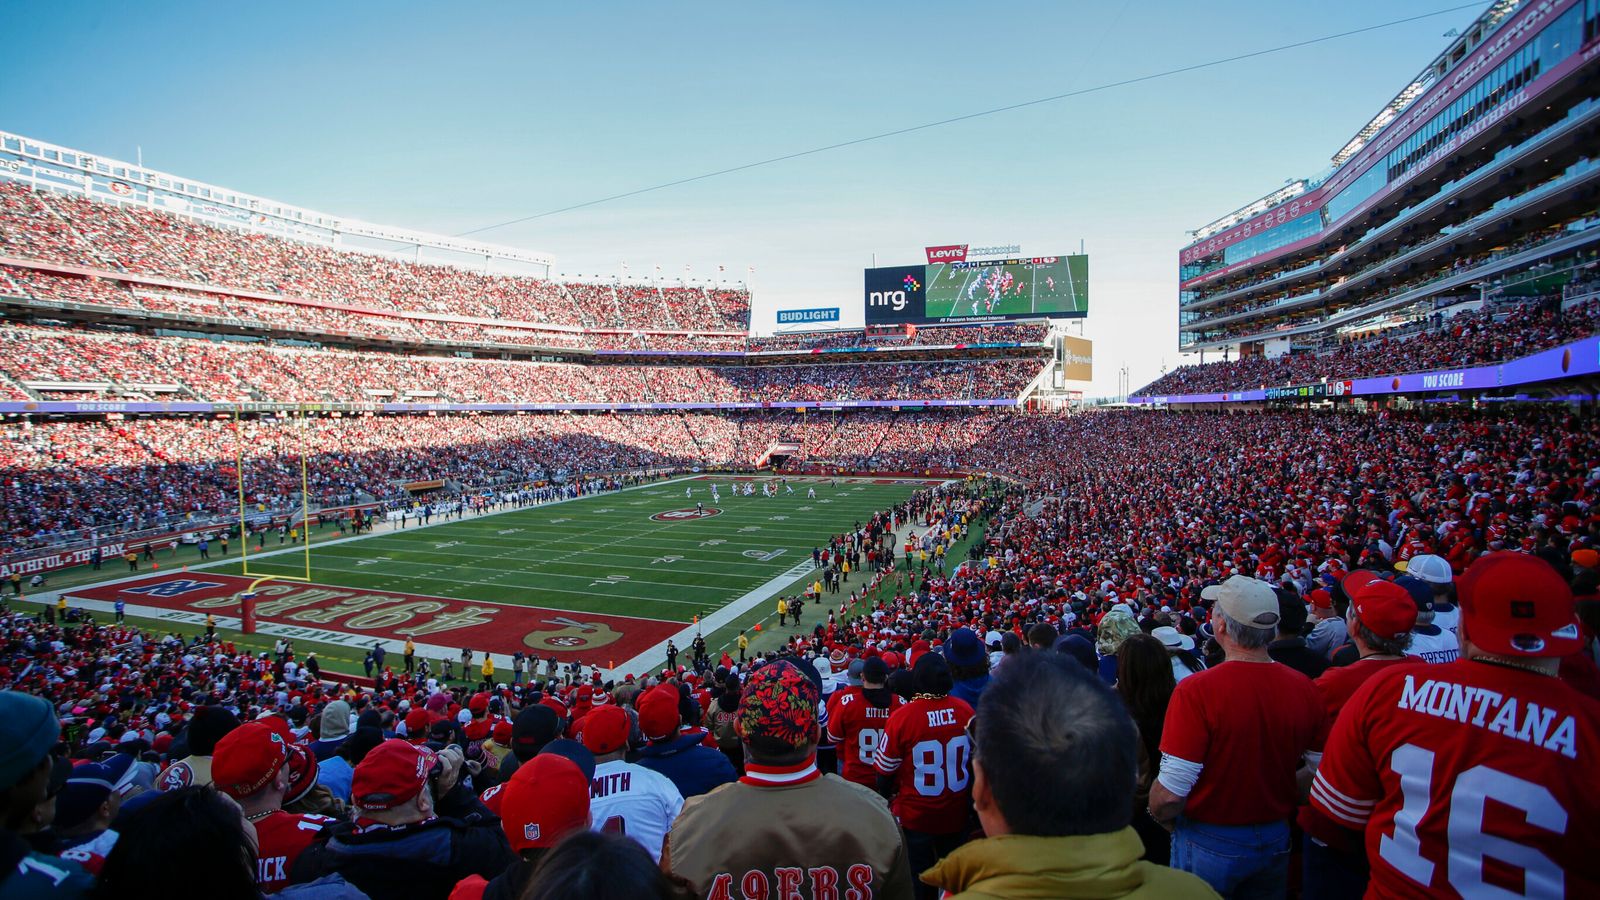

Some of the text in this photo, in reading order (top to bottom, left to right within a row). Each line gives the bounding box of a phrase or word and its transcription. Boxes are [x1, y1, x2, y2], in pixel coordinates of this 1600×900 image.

[1375, 117, 1411, 154] SUPER
[1413, 86, 1450, 123] BOWL
[1390, 164, 1417, 193] HOME
[1418, 157, 1431, 172] OF
[1433, 140, 1457, 162] THE
[1460, 90, 1530, 146] FAITHFUL
[1423, 373, 1465, 388] YOU SCORE
[76, 403, 127, 411] YOU SCORE
[101, 543, 128, 557] BAY
[187, 584, 501, 638] 49ERS
[865, 707, 890, 718] KITTLE
[926, 708, 957, 728] RICE
[1397, 675, 1577, 760] MONTANA
[911, 734, 971, 797] 80
[1379, 742, 1569, 900] 16
[706, 864, 872, 900] 49ERS
